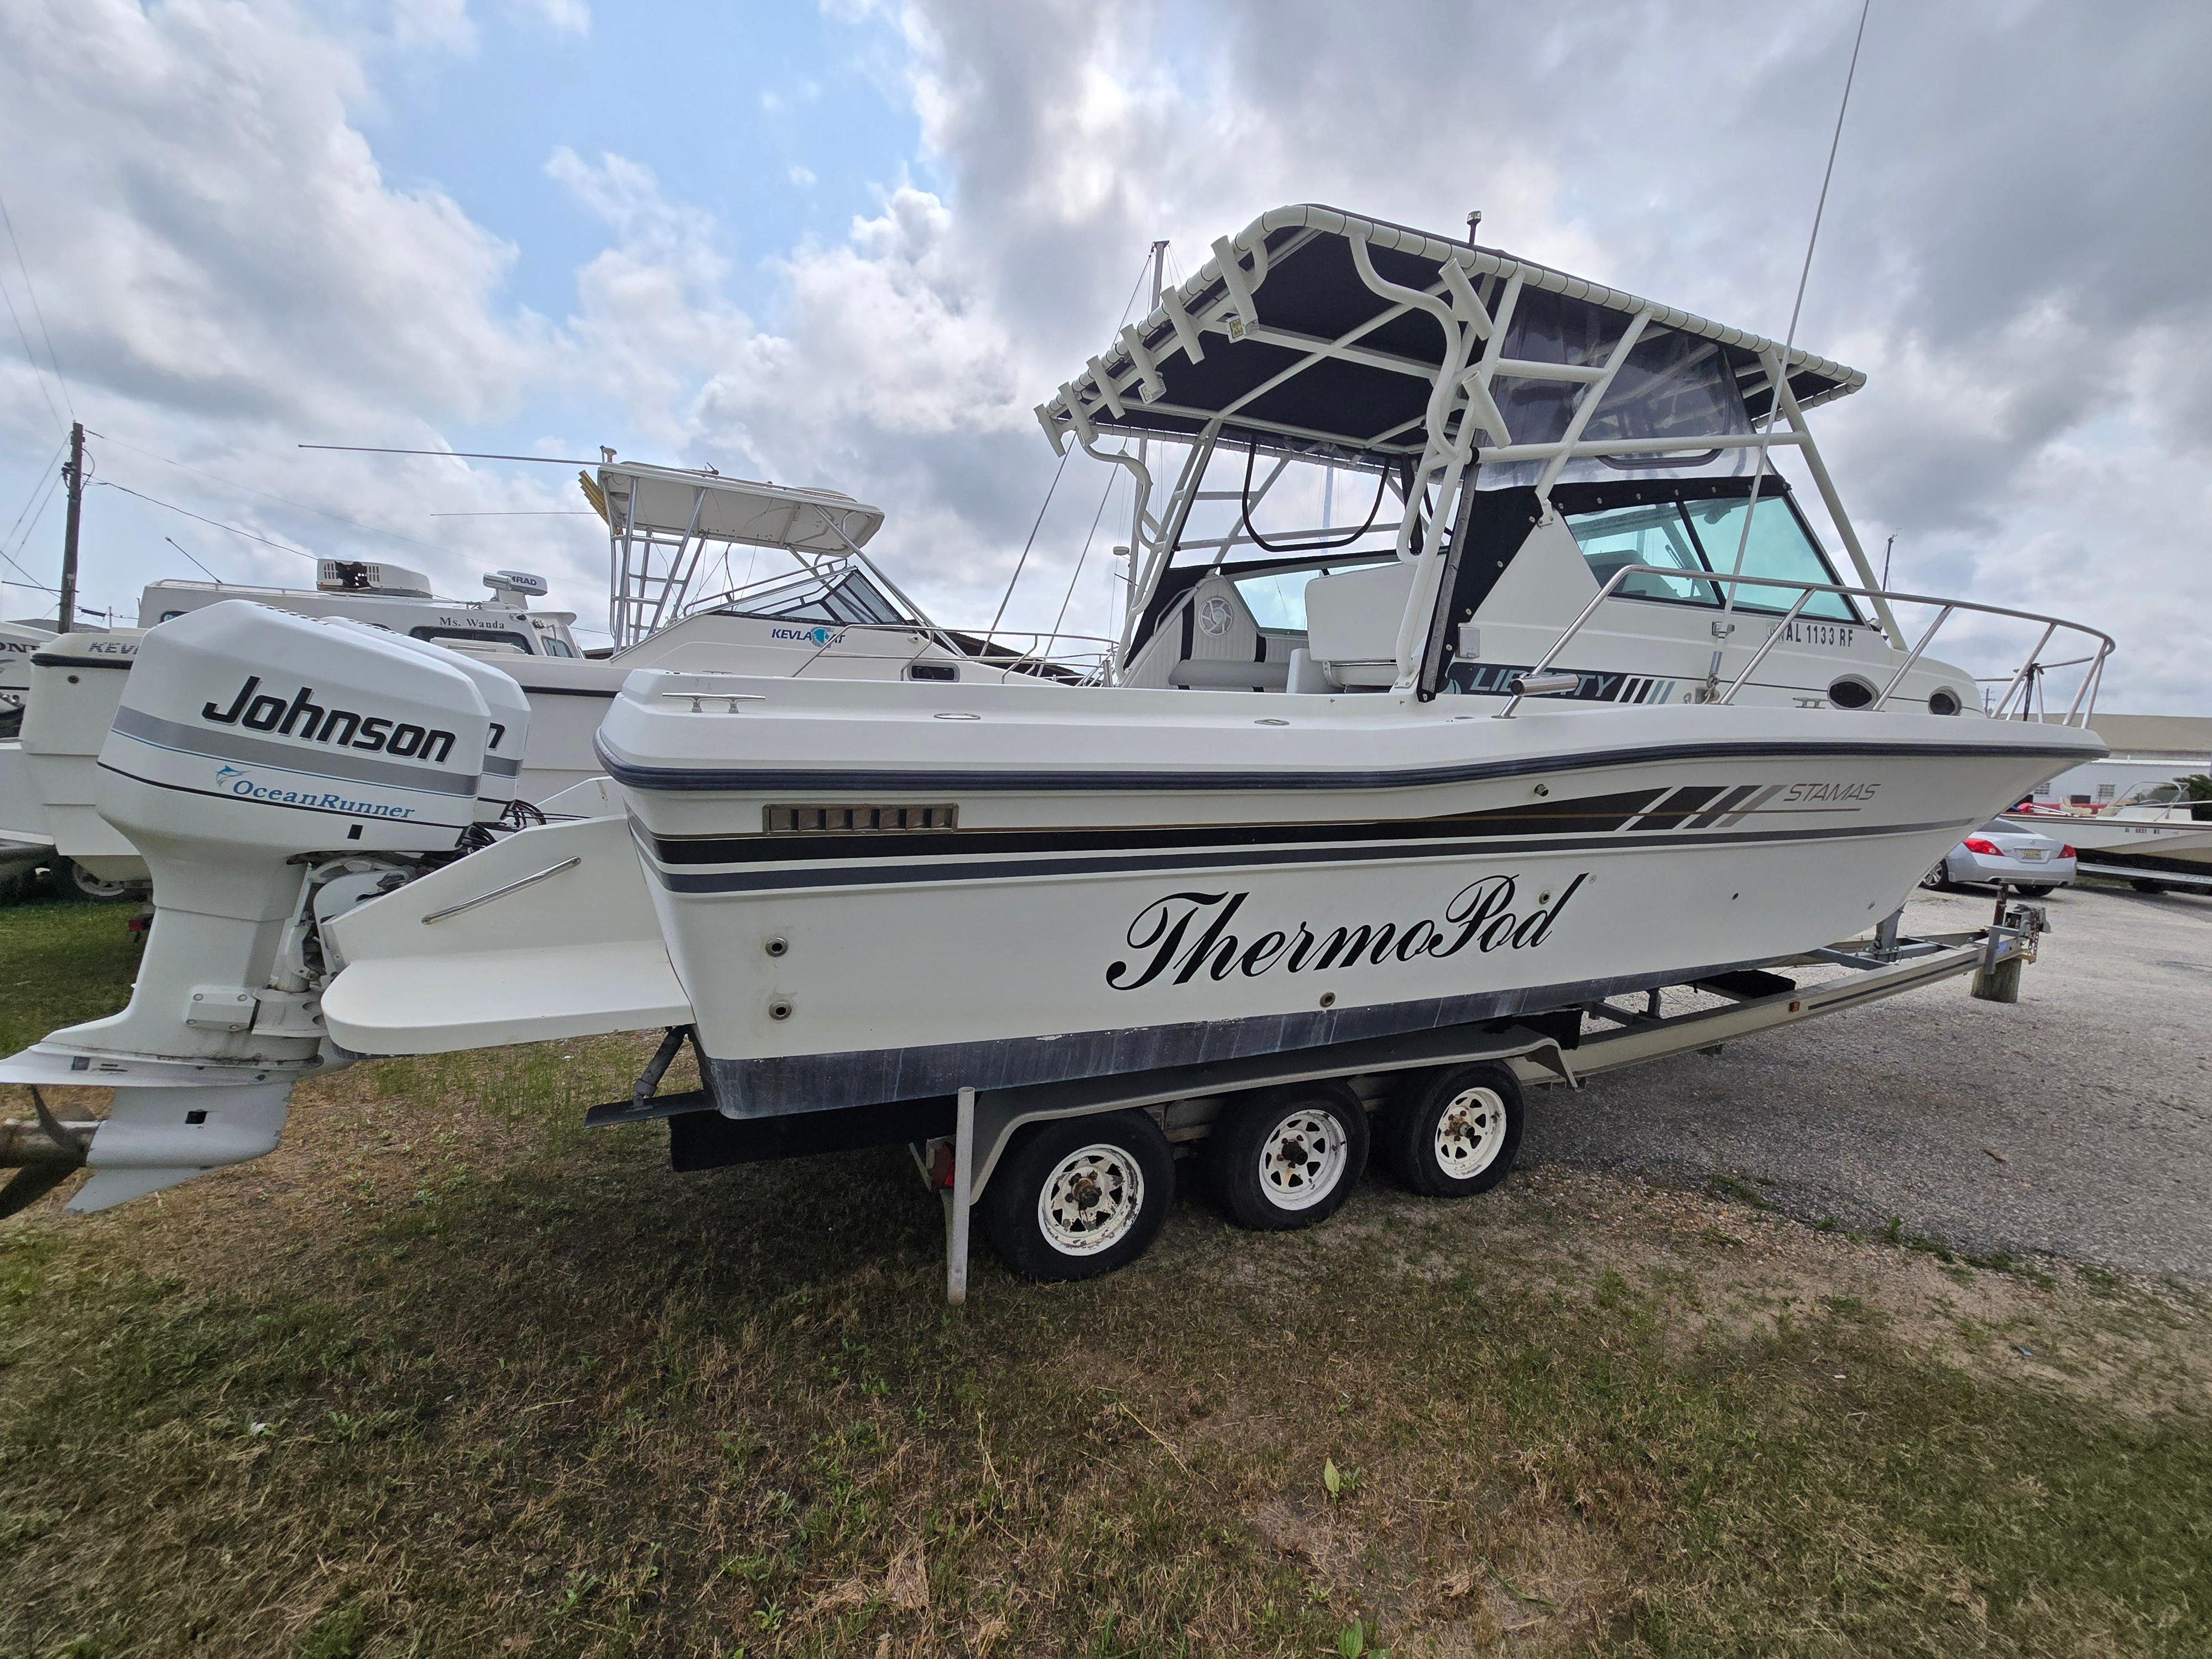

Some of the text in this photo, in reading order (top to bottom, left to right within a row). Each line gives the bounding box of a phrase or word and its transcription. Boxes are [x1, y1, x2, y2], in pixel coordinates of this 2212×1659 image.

[502, 575, 536, 585] MRAD
[440, 617, 504, 629] Ms. Wanda
[1786, 622, 1801, 643] AL
[1807, 625, 1834, 645] 1133
[1840, 628, 1853, 647] RF
[1470, 667, 1617, 697] LIBTY
[202, 676, 456, 764] Johnson
[233, 780, 415, 818] OceanRunner
[1783, 784, 1881, 801] STAMAS
